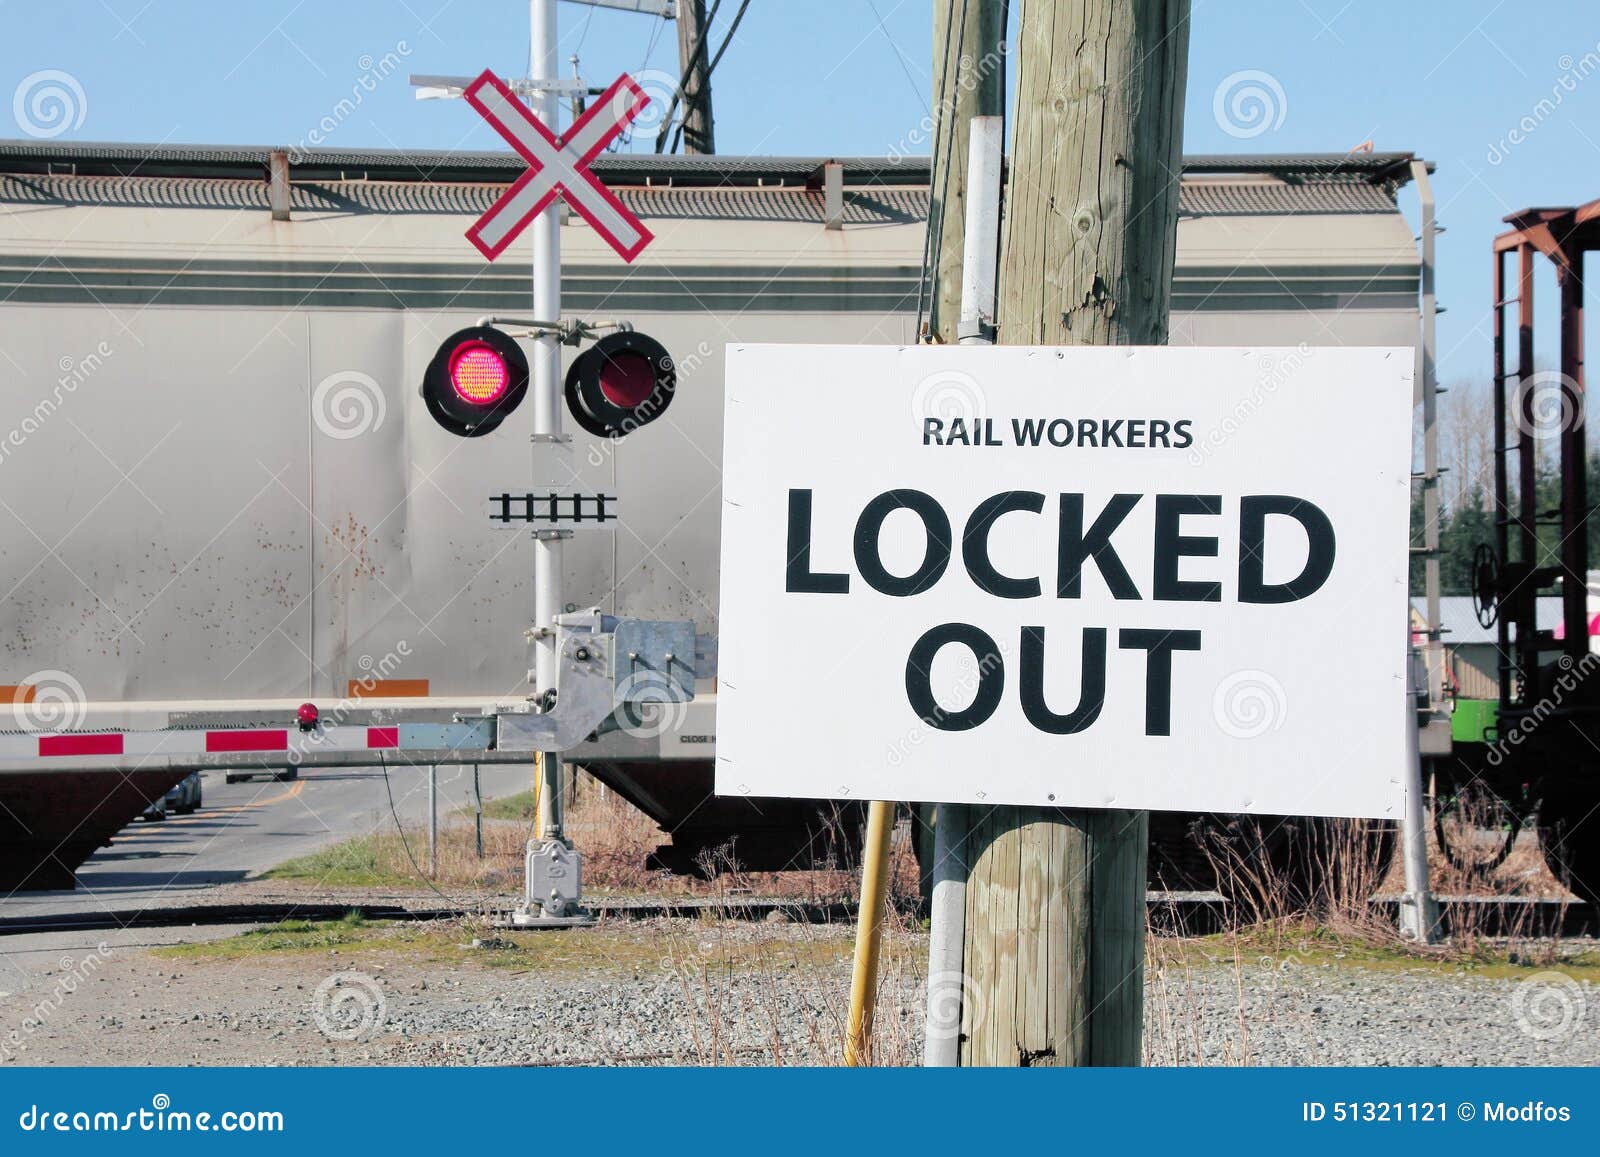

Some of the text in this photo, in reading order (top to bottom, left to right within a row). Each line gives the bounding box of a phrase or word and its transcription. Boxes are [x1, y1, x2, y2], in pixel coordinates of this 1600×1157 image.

[924, 418, 1192, 448] RAIL WORKERS
[786, 489, 1335, 604] LOCKED
[906, 623, 1201, 736] OUT
